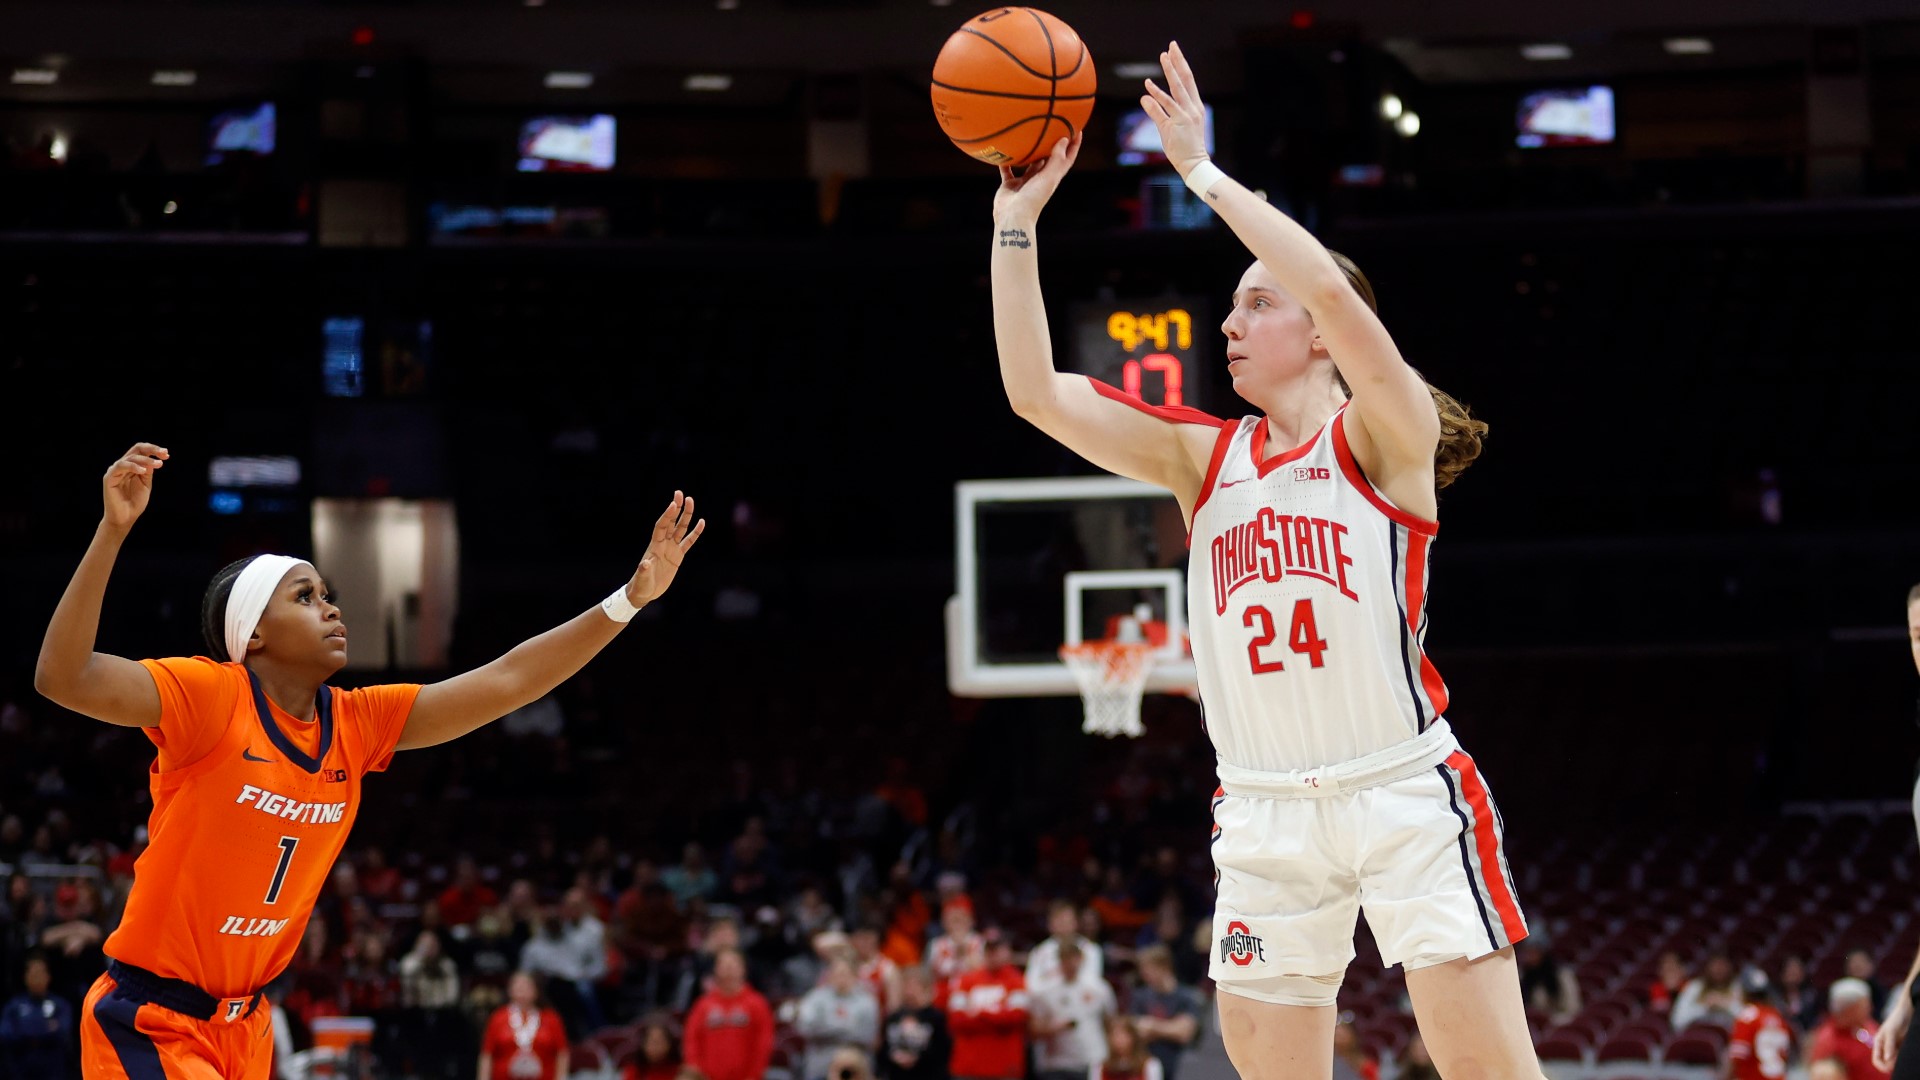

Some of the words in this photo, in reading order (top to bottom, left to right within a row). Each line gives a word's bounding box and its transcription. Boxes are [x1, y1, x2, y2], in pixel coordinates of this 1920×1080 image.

[1107, 309, 1192, 352] 9:47
[1122, 353, 1183, 407] 17
[1242, 598, 1328, 675] 24
[235, 784, 346, 824] FIGHTING
[263, 835, 300, 905] 1
